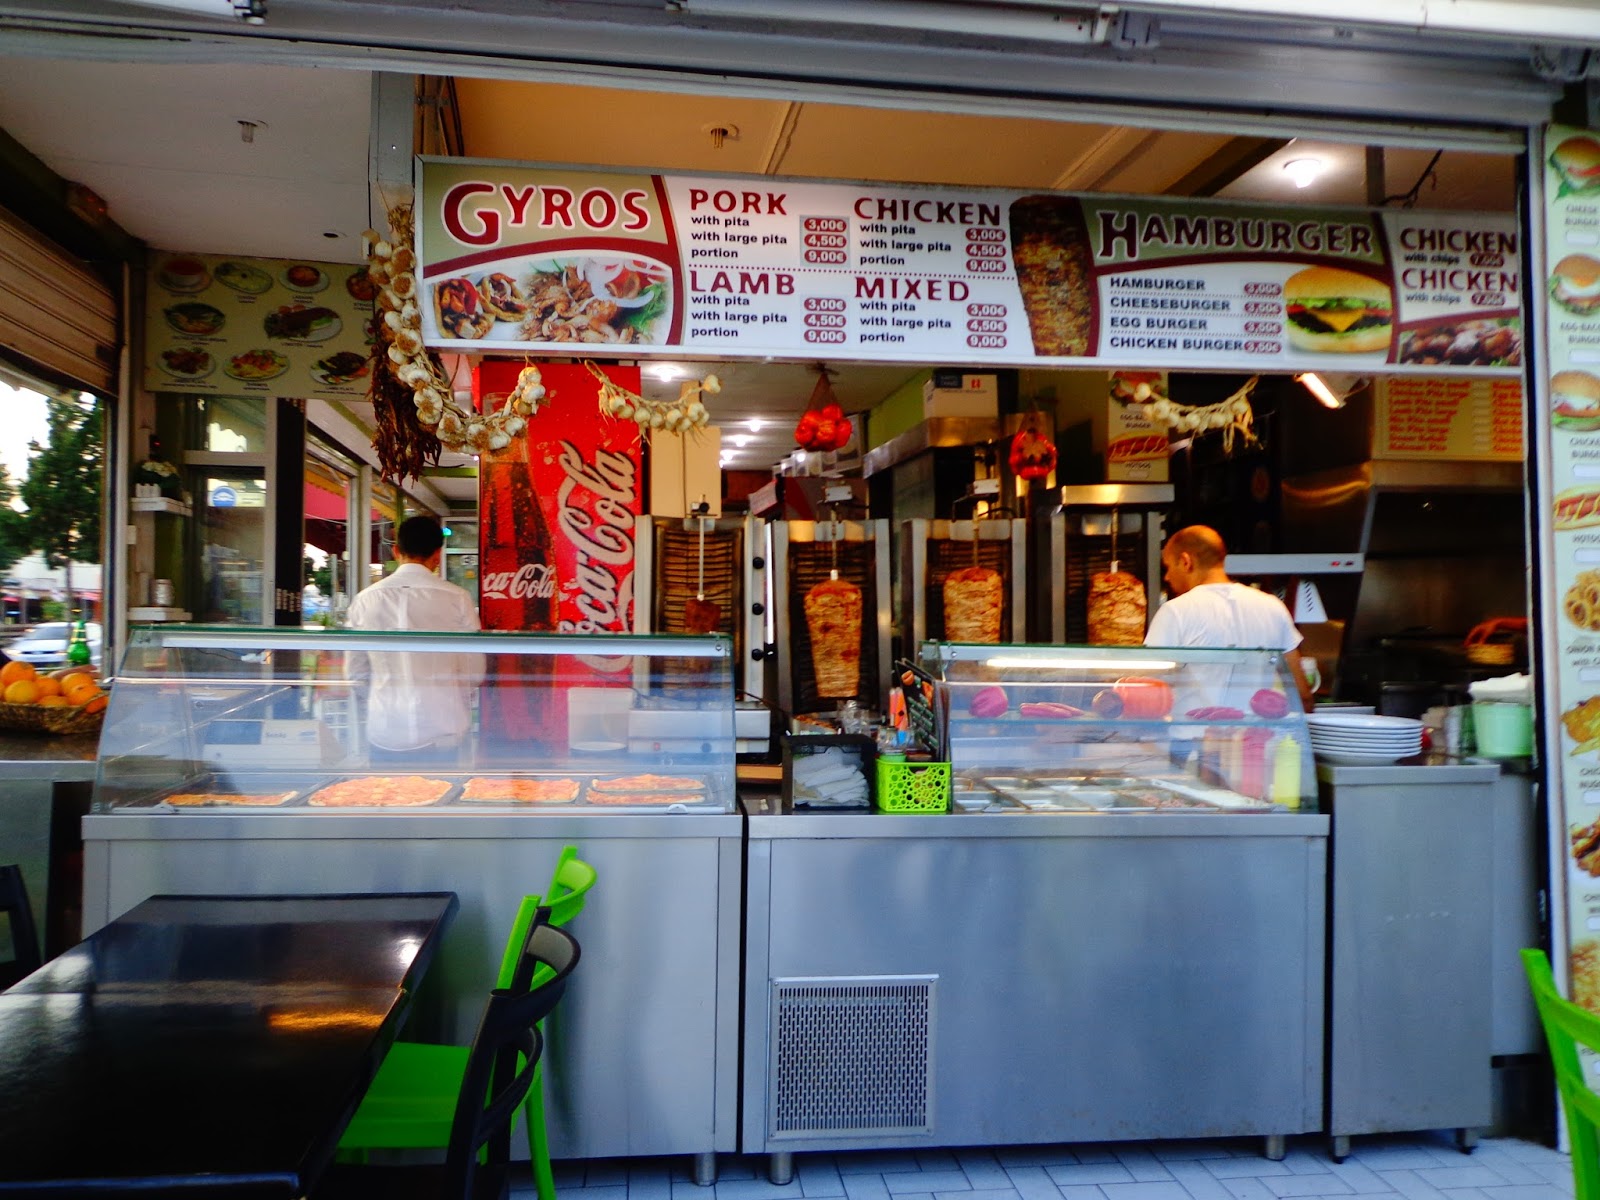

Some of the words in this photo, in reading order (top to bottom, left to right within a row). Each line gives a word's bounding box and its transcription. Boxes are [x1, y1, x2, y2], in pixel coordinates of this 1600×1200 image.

[689, 189, 787, 215] PORK
[442, 182, 651, 246] GYROS
[854, 197, 1000, 226] CHICKEN
[691, 216, 720, 226] with
[724, 217, 749, 227] pita
[808, 219, 843, 231] 3,00€
[691, 232, 720, 242] with
[724, 233, 758, 245] large
[762, 235, 787, 245] pita
[808, 235, 843, 247] 4,50€
[860, 224, 888, 233] with
[891, 226, 916, 236] pita
[970, 230, 1004, 241] 3,00€
[1098, 211, 1372, 259] HAMBURGER
[860, 239, 888, 249] with
[892, 241, 924, 252] large
[927, 243, 951, 252] pita
[970, 245, 1004, 256] 4,50€
[1400, 228, 1516, 254] CHICKEN
[691, 247, 738, 259] portion
[808, 251, 843, 263] 9,00€
[860, 255, 905, 266] portion
[970, 260, 1004, 271] 9,00€
[1405, 254, 1426, 262] with
[690, 271, 795, 295] LAMB
[1110, 277, 1205, 291] HAMBURGER
[1402, 268, 1517, 292] CHICKEN
[855, 277, 969, 301] MIXED
[1406, 293, 1428, 301] with
[691, 295, 720, 305] with
[724, 297, 750, 307] pita
[808, 299, 843, 311] 3,00€
[860, 301, 888, 310] with
[891, 303, 916, 313] pita
[971, 305, 1004, 316] 3,00€
[1110, 298, 1230, 311] CHEESEBURGER
[691, 312, 720, 321] with
[725, 313, 758, 324] large
[762, 314, 787, 324] pita
[808, 315, 843, 326] 4,50€
[860, 316, 888, 326] with
[892, 317, 924, 329] large
[927, 320, 951, 329] pita
[971, 320, 1005, 331] 4,50€
[1110, 317, 1141, 329] EGG
[1147, 318, 1207, 330] BURGER
[691, 327, 738, 339] portion
[808, 331, 843, 343] 9,00€
[860, 333, 905, 343] portion
[971, 336, 1005, 346] 9,00€
[1110, 338, 1177, 349] CHICKEN
[1183, 340, 1242, 351] BURGER
